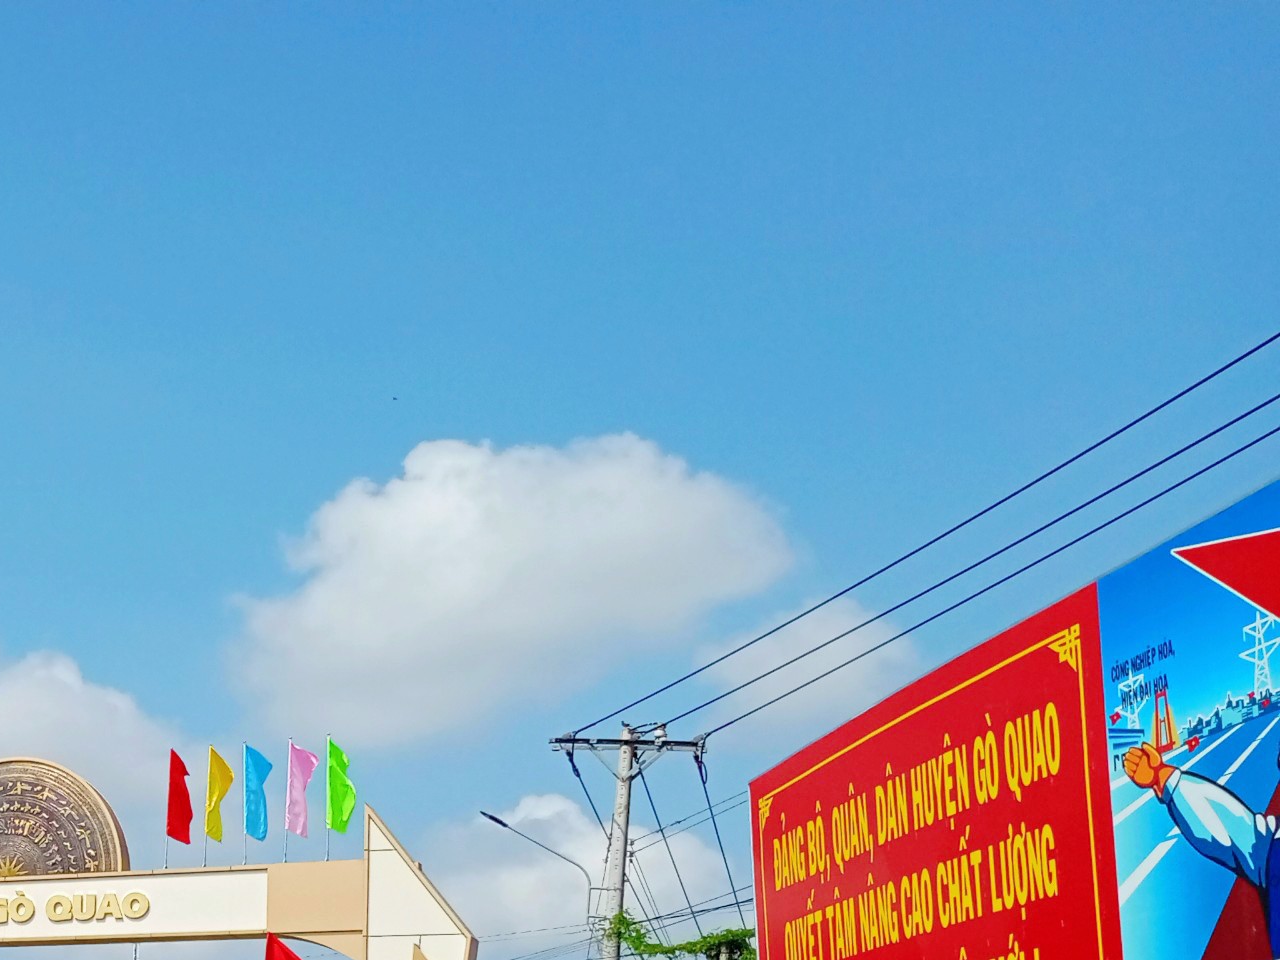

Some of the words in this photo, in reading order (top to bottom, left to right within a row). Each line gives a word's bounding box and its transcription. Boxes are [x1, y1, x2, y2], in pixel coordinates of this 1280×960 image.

[773, 812, 807, 891] ĐẢNG
[806, 800, 831, 884] BỘ,
[832, 782, 874, 875] QUÂN,
[875, 762, 909, 846] DÂN
[910, 733, 970, 830] HUYỆN
[973, 712, 999, 805] GÒ
[1004, 702, 1060, 802] QUAO
[45, 892, 150, 923] QUAO
[858, 872, 899, 952] NÂNG
[900, 867, 933, 940] CAO
[936, 825, 983, 929] CHẤT
[988, 822, 1058, 921] LƯỢNG
